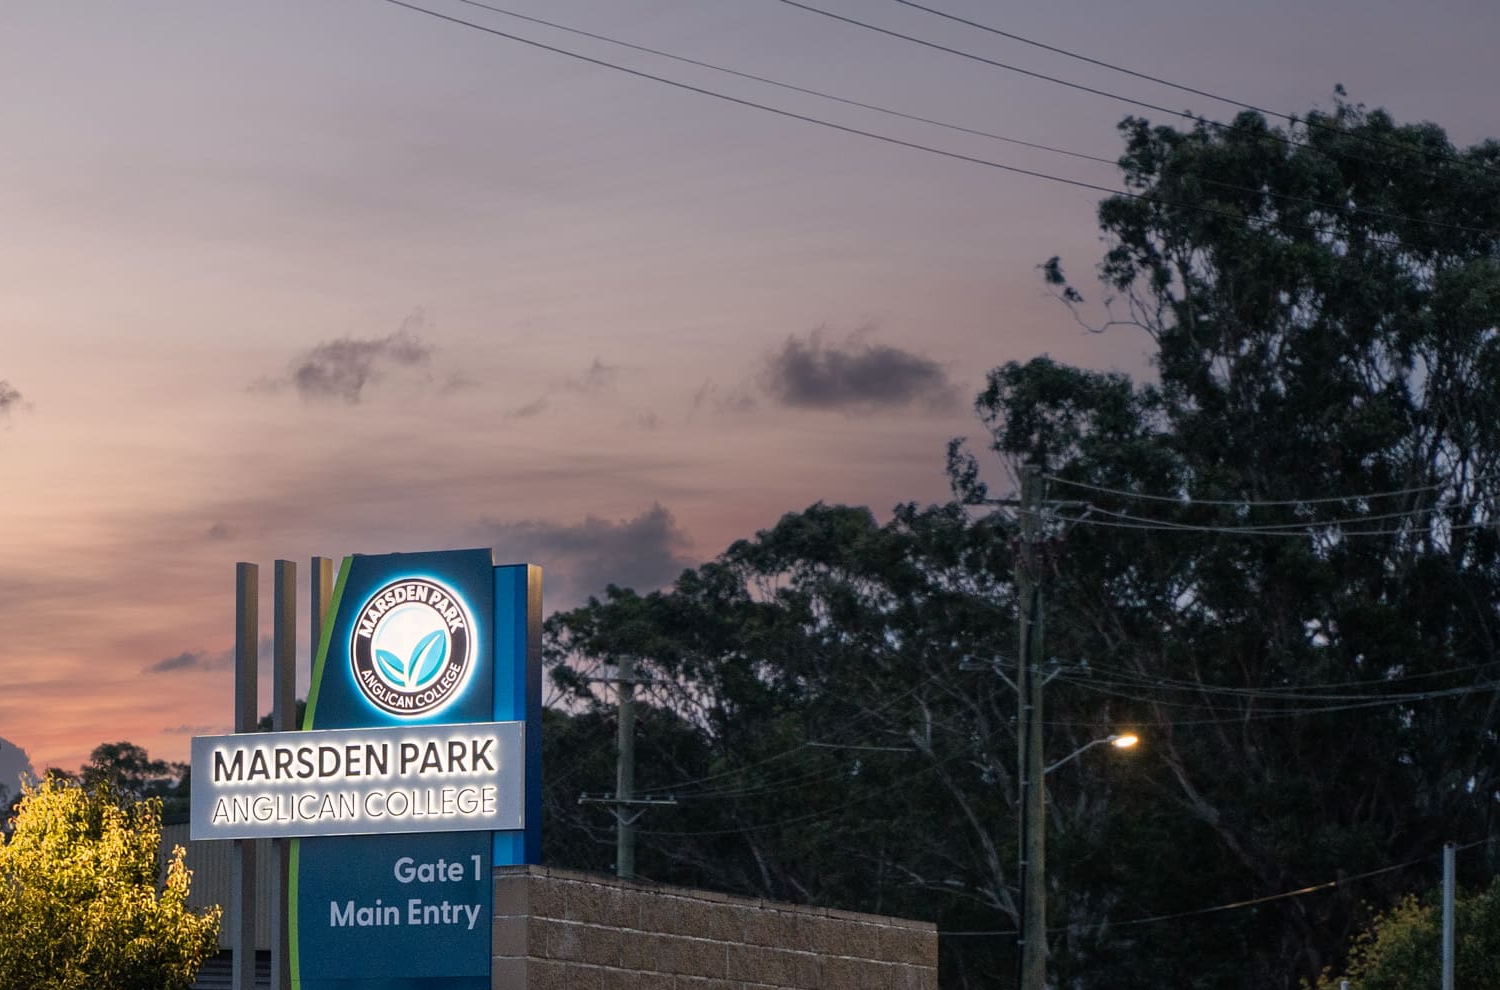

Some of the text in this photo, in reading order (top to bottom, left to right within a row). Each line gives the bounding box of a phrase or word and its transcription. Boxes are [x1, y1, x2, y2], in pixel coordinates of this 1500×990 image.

[359, 585, 464, 638] MARSDEN PARK
[361, 662, 461, 708] ANGLICAN COLLEGE
[214, 739, 495, 782] MARSDEN PARK
[212, 788, 496, 824] ANGLICAN COLLEGE
[394, 855, 481, 883] Gate 1
[330, 899, 481, 930] Main Entry
